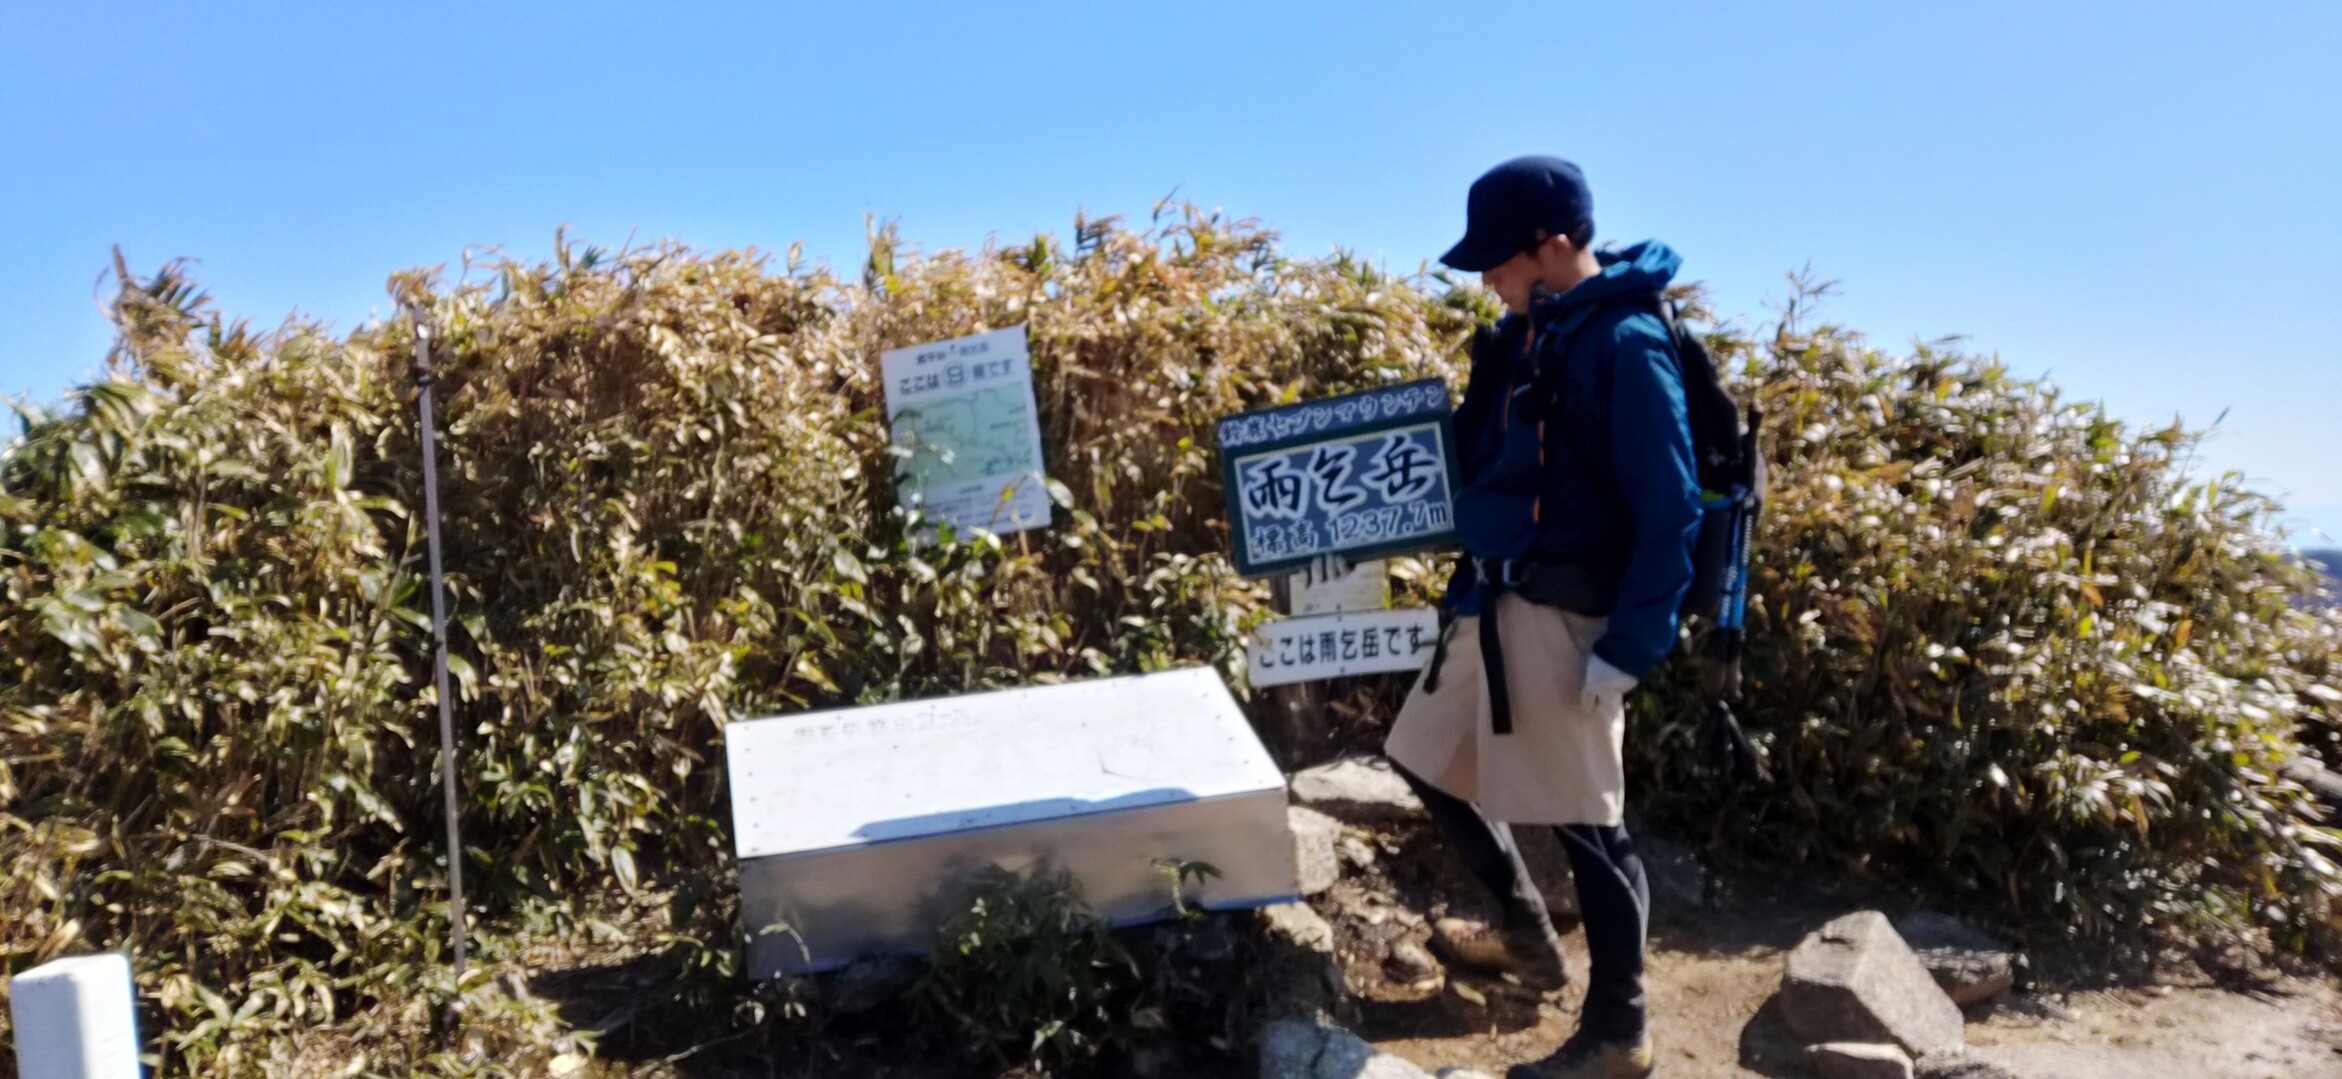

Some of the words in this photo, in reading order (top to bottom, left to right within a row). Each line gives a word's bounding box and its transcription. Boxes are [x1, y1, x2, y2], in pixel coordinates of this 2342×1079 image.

[1246, 434, 1439, 516] 雨乞岳
[1252, 520, 1318, 559] 標高
[1327, 499, 1448, 544] 1237.7m
